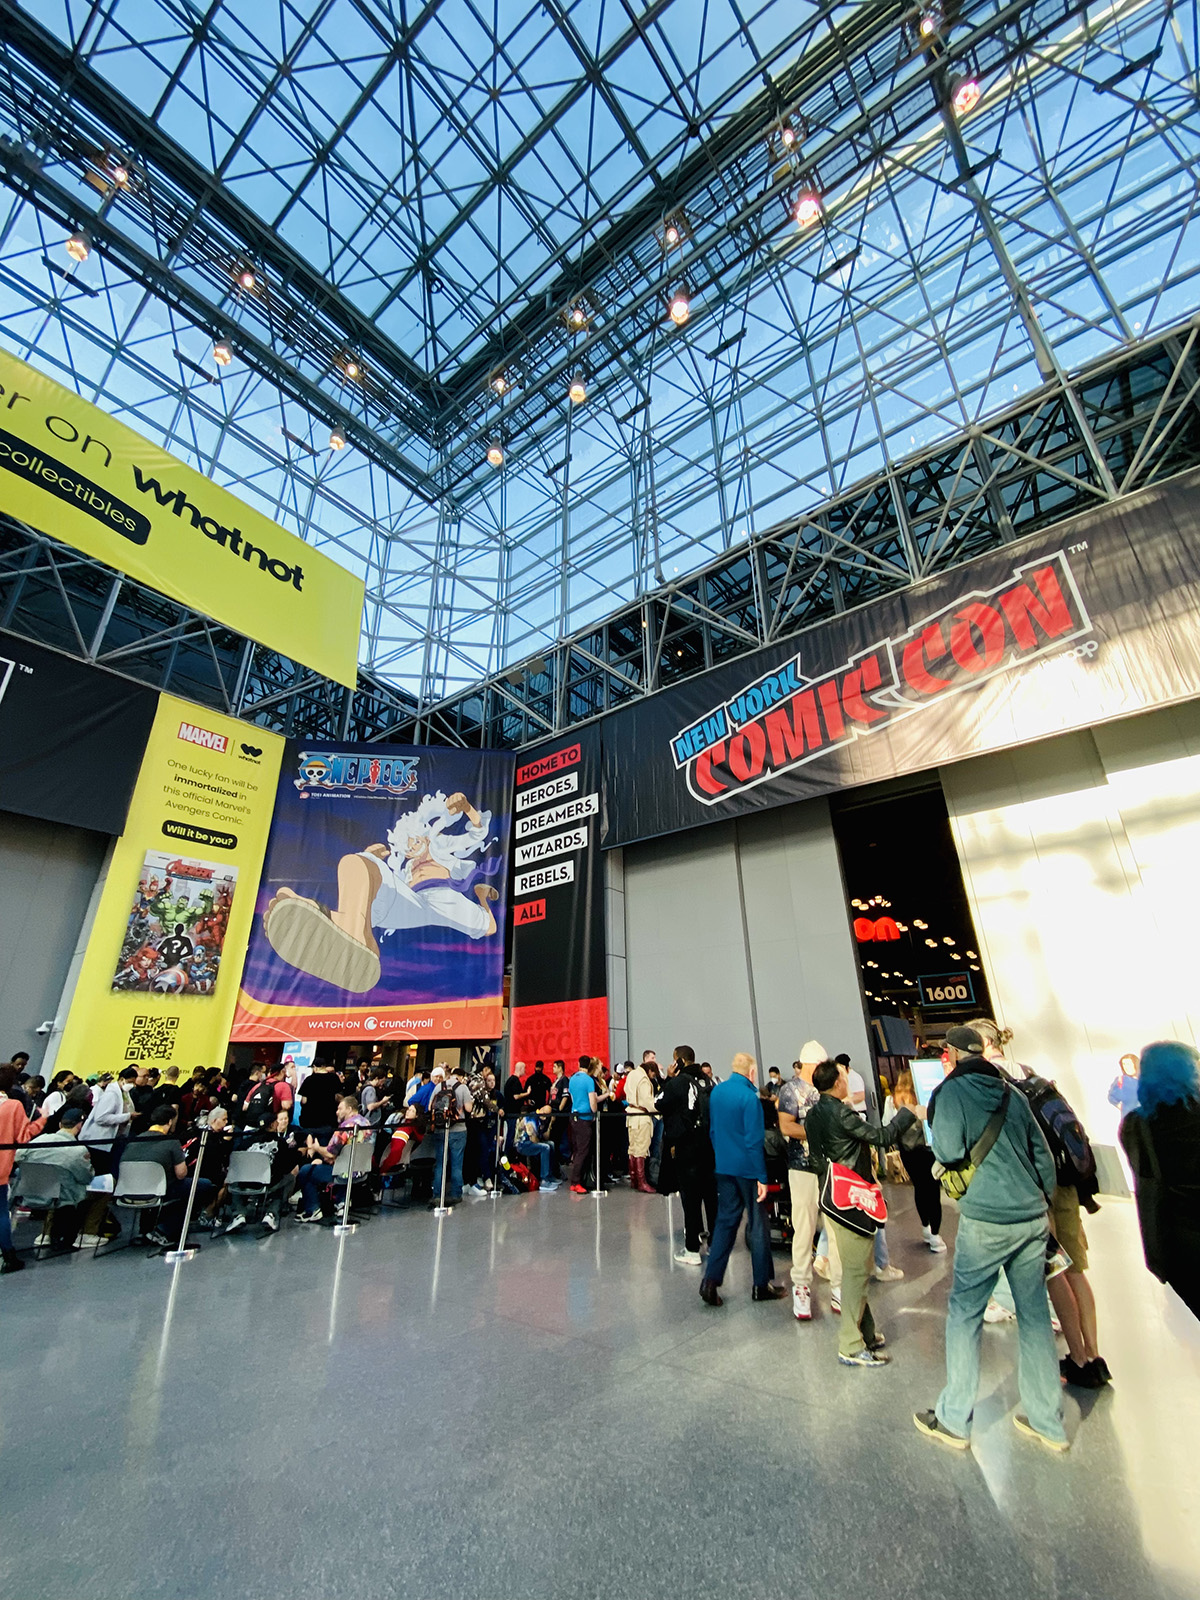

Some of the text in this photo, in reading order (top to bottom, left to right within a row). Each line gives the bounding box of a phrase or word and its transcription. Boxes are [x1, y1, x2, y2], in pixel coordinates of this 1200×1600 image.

[0, 441, 137, 533] collectibles
[0, 384, 305, 592] r on whatnot
[695, 565, 1073, 794] COMIC CON
[675, 662, 802, 762] NEW YORK
[179, 723, 226, 753] MARVEL
[167, 759, 259, 792] One lucky fan will be
[521, 748, 578, 781] HOME TO
[163, 785, 251, 815] this official Marvel's
[173, 774, 247, 801] immortalized in
[521, 778, 574, 807] HEROES,
[164, 800, 244, 826] Avengers Comic.
[521, 799, 596, 834] DREAMERS,
[166, 824, 233, 847] Will it be you?
[520, 832, 585, 860] WIZARDS,
[520, 866, 570, 891] REBELS,
[520, 903, 543, 921] ALL
[926, 985, 967, 1001] 1600
[308, 1018, 433, 1030] WATCH ON crunchyroll
[514, 1030, 572, 1056] NYCC
